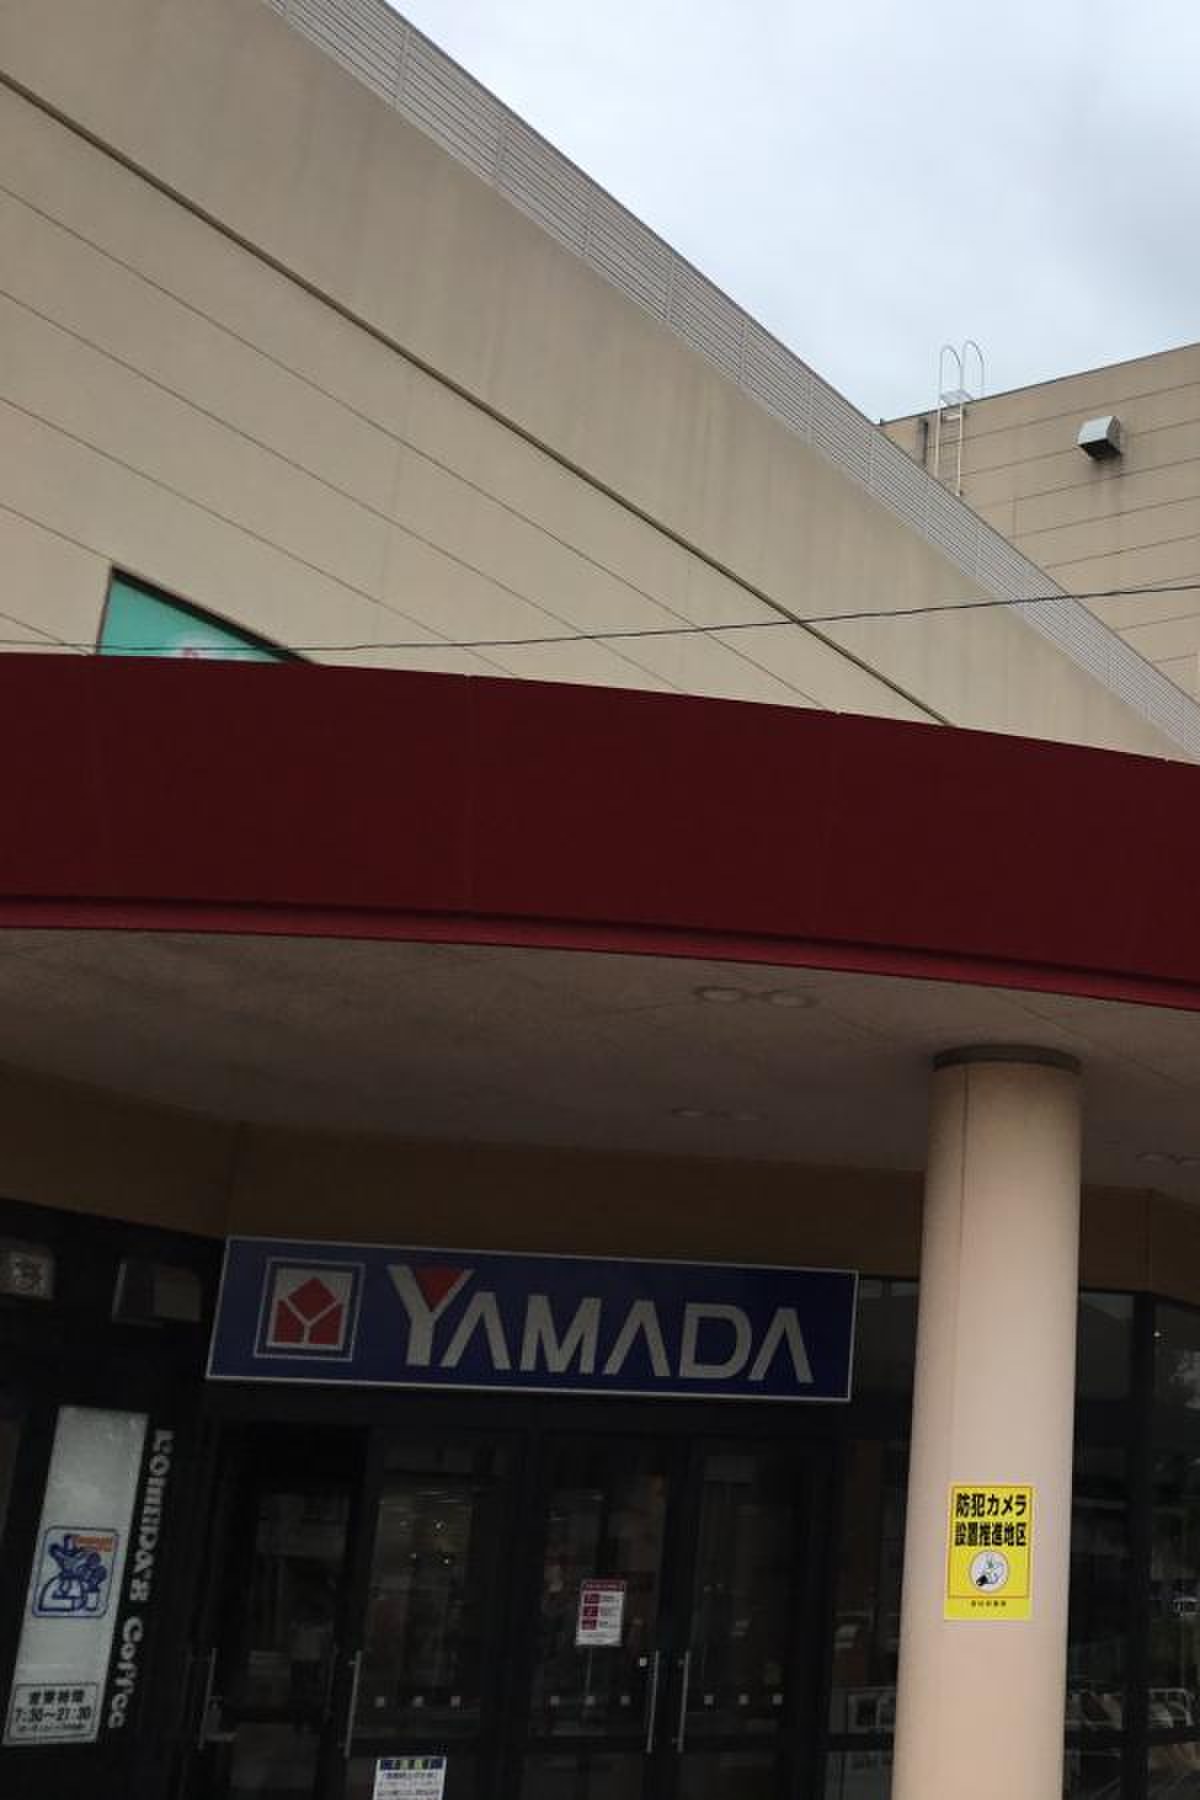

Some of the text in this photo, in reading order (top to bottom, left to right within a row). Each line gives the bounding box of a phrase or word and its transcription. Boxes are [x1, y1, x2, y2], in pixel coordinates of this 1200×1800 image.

[386, 1264, 814, 1384] YAMADA
[955, 1492, 1027, 1518] 防犯カメラ
[955, 1522, 1027, 1547] 設置推進地区
